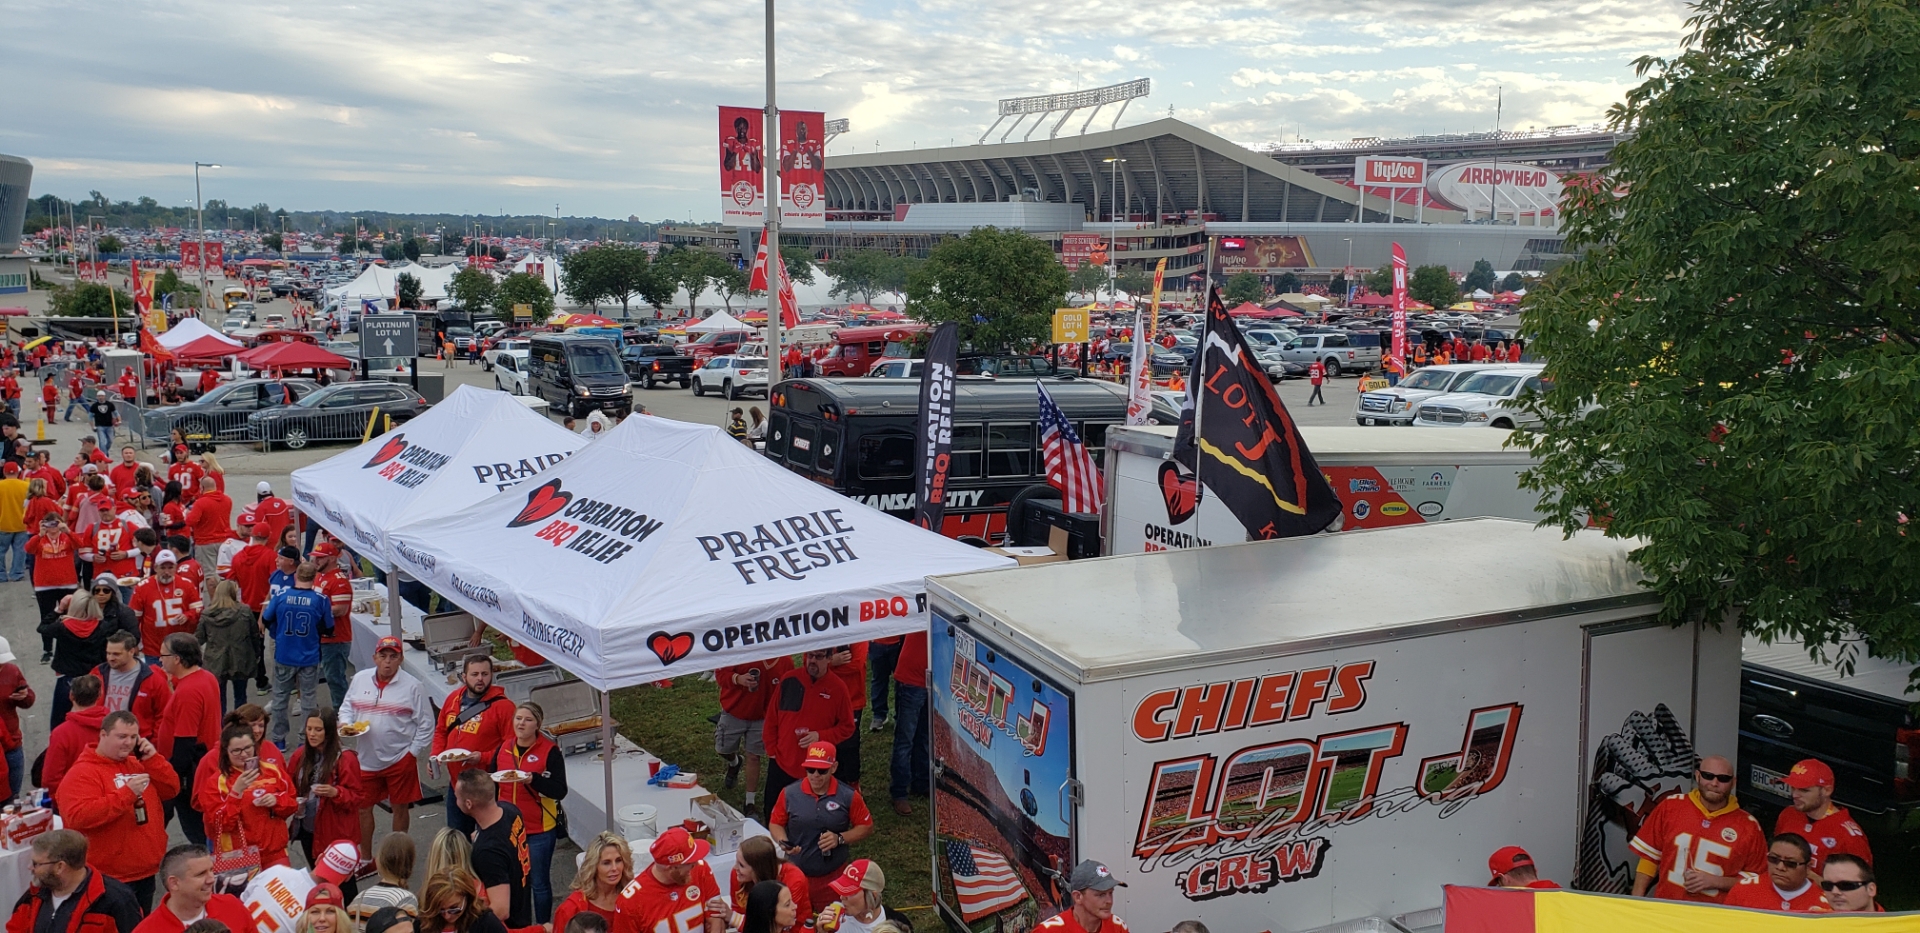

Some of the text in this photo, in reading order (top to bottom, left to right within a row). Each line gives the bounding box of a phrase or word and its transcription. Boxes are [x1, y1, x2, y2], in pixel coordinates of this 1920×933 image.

[734, 152, 752, 171] 14
[1458, 167, 1548, 187] ARROWHEAD
[366, 321, 410, 329] PLATINUM
[375, 329, 391, 337] LOT
[1368, 380, 1387, 389] GOLD
[399, 445, 452, 471] OPERATION
[473, 451, 573, 483] PRAIR
[173, 472, 192, 490] 10
[377, 461, 430, 489] BBQ RELIEF
[930, 453, 950, 504] BBQ
[850, 493, 917, 512] KANSA
[564, 498, 664, 542] OPERATION
[696, 508, 855, 561] PRAIRIE
[97, 528, 122, 549] 87
[534, 519, 633, 564] BBQ RELIEF
[1145, 541, 1167, 552] BB
[732, 535, 859, 585] FRESH
[152, 598, 183, 628] 15
[286, 595, 311, 606] HILTON
[284, 610, 311, 637] 13
[522, 610, 585, 658] PRAIRIE FRESH
[702, 606, 849, 651] OPERATION
[859, 596, 908, 622] BBQ
[1131, 660, 1376, 743] CHIEFS
[958, 707, 994, 750] CREW
[1132, 702, 1524, 859] LOT J
[328, 850, 355, 870] chiefs
[1176, 837, 1332, 902] CREW
[1668, 832, 1731, 897] 15
[265, 877, 303, 919] MAHOMES
